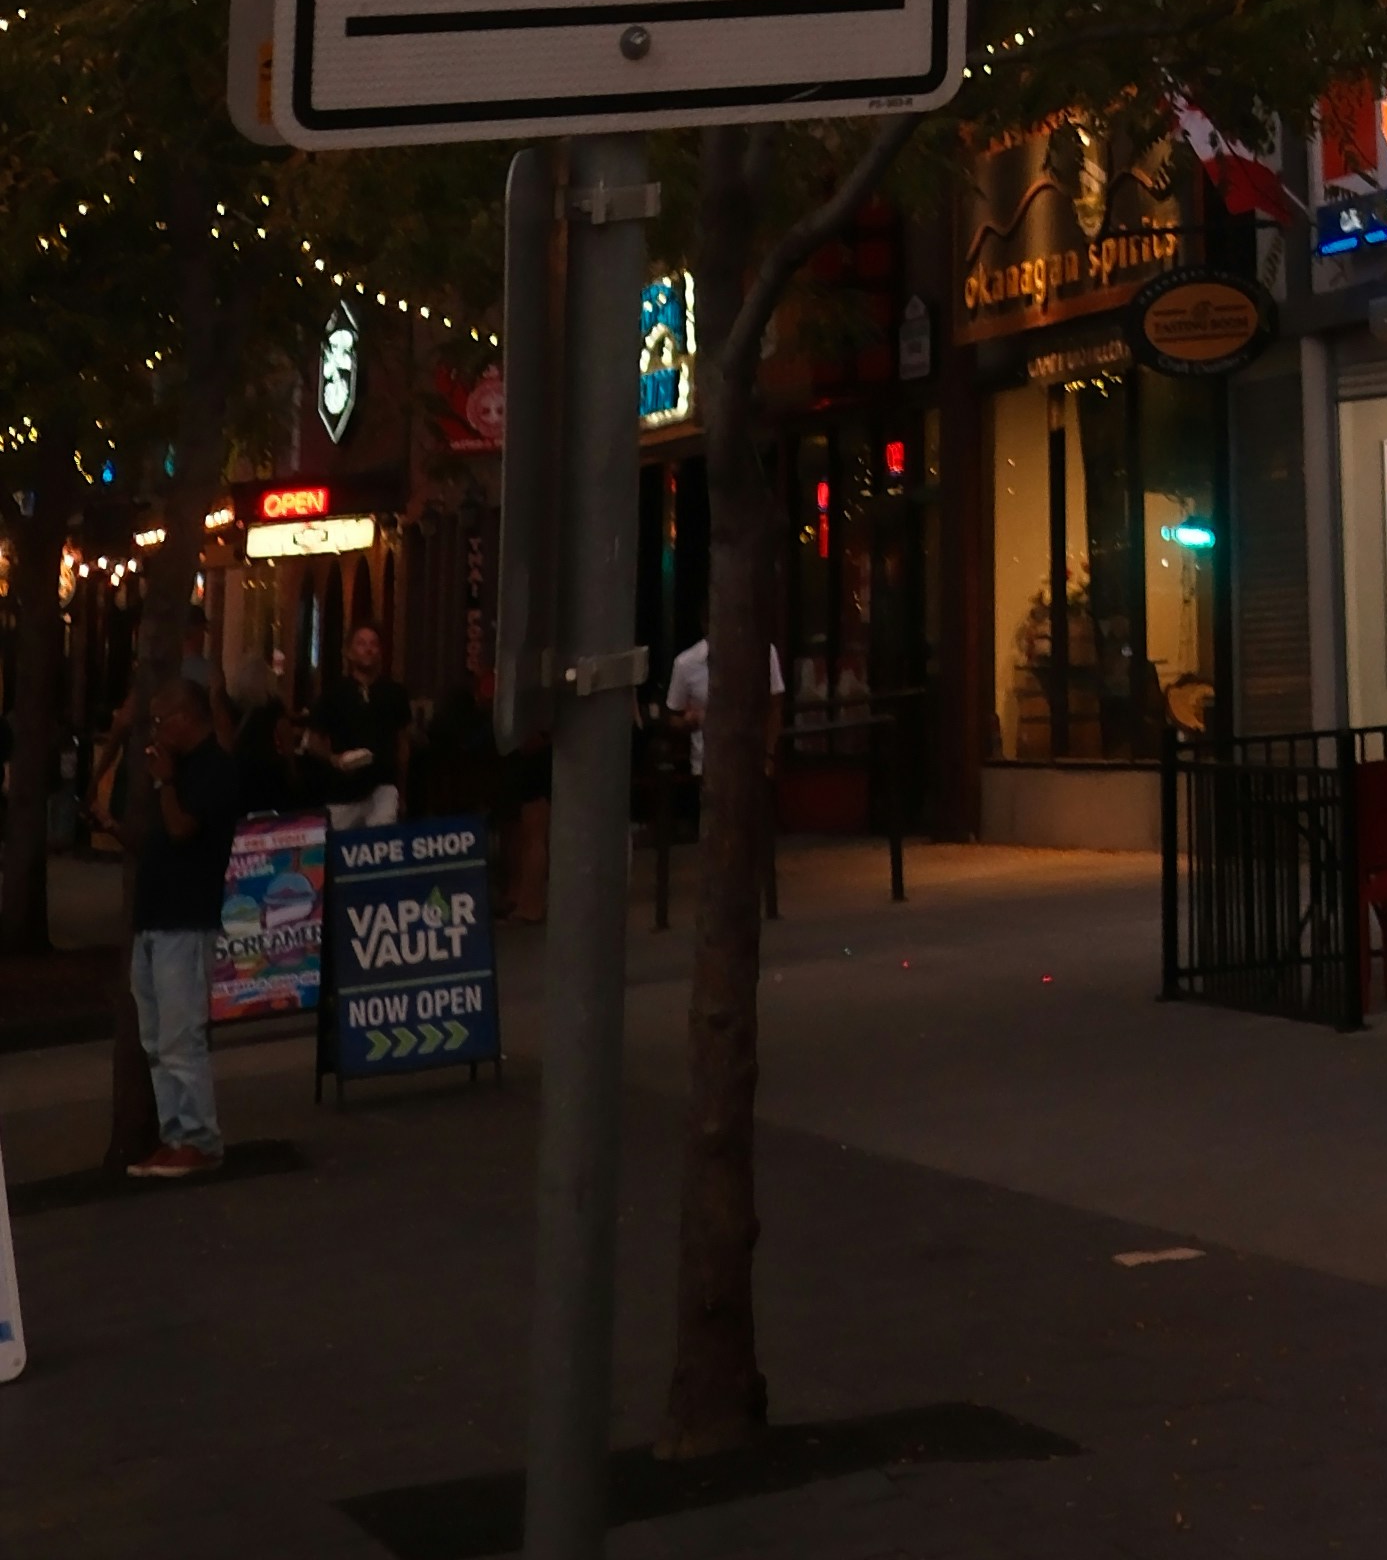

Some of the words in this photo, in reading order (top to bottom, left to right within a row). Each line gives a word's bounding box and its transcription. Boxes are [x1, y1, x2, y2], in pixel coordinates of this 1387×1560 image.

[963, 250, 1080, 312] okanagan
[1088, 216, 1179, 286] spirits
[263, 488, 325, 518] OPEN
[340, 839, 405, 868] VAPE
[411, 831, 476, 861] SHOP
[346, 891, 476, 939] VAPOR
[350, 925, 468, 970] VAULT
[347, 994, 410, 1028] NOW
[416, 985, 483, 1019] OPEN
